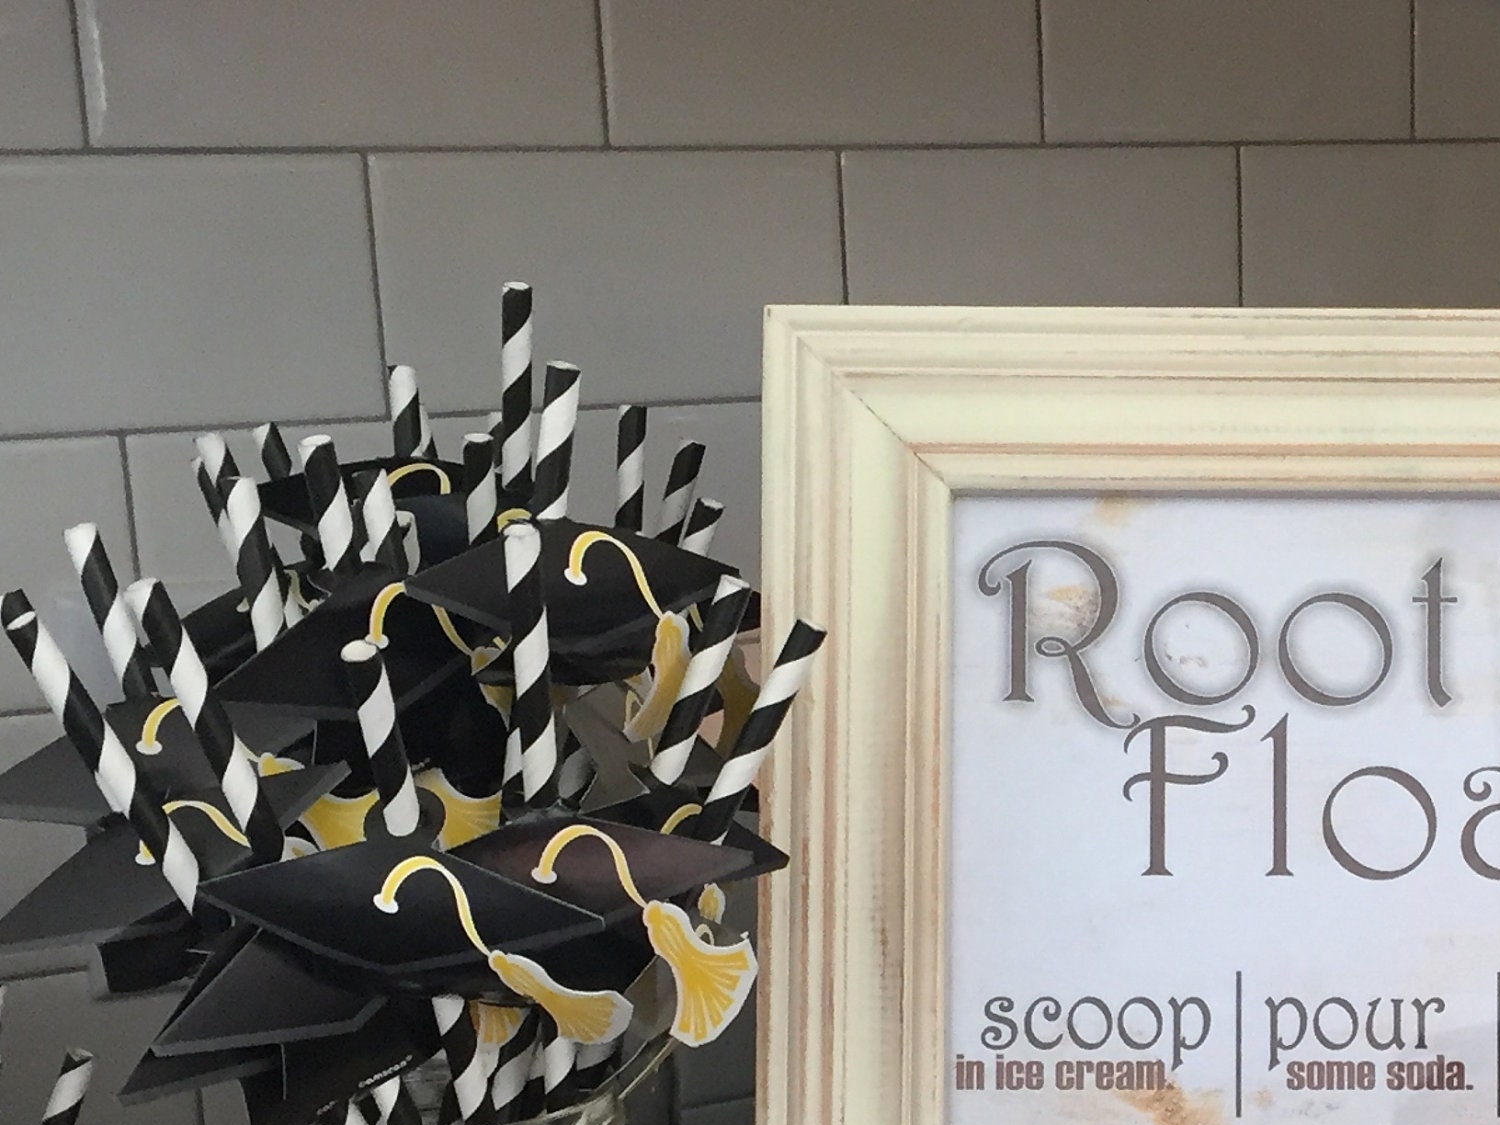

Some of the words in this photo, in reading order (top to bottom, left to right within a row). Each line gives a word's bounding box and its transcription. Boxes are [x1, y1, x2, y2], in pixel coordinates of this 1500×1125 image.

[977, 539, 1458, 729] Root
[980, 996, 1212, 1071] scoop
[1265, 996, 1446, 1071] pour
[955, 1053, 985, 1091] in
[995, 1053, 1045, 1091] ice
[1055, 1059, 1176, 1092] cream.
[1286, 1059, 1376, 1091] some
[1386, 1054, 1474, 1091] soda.
